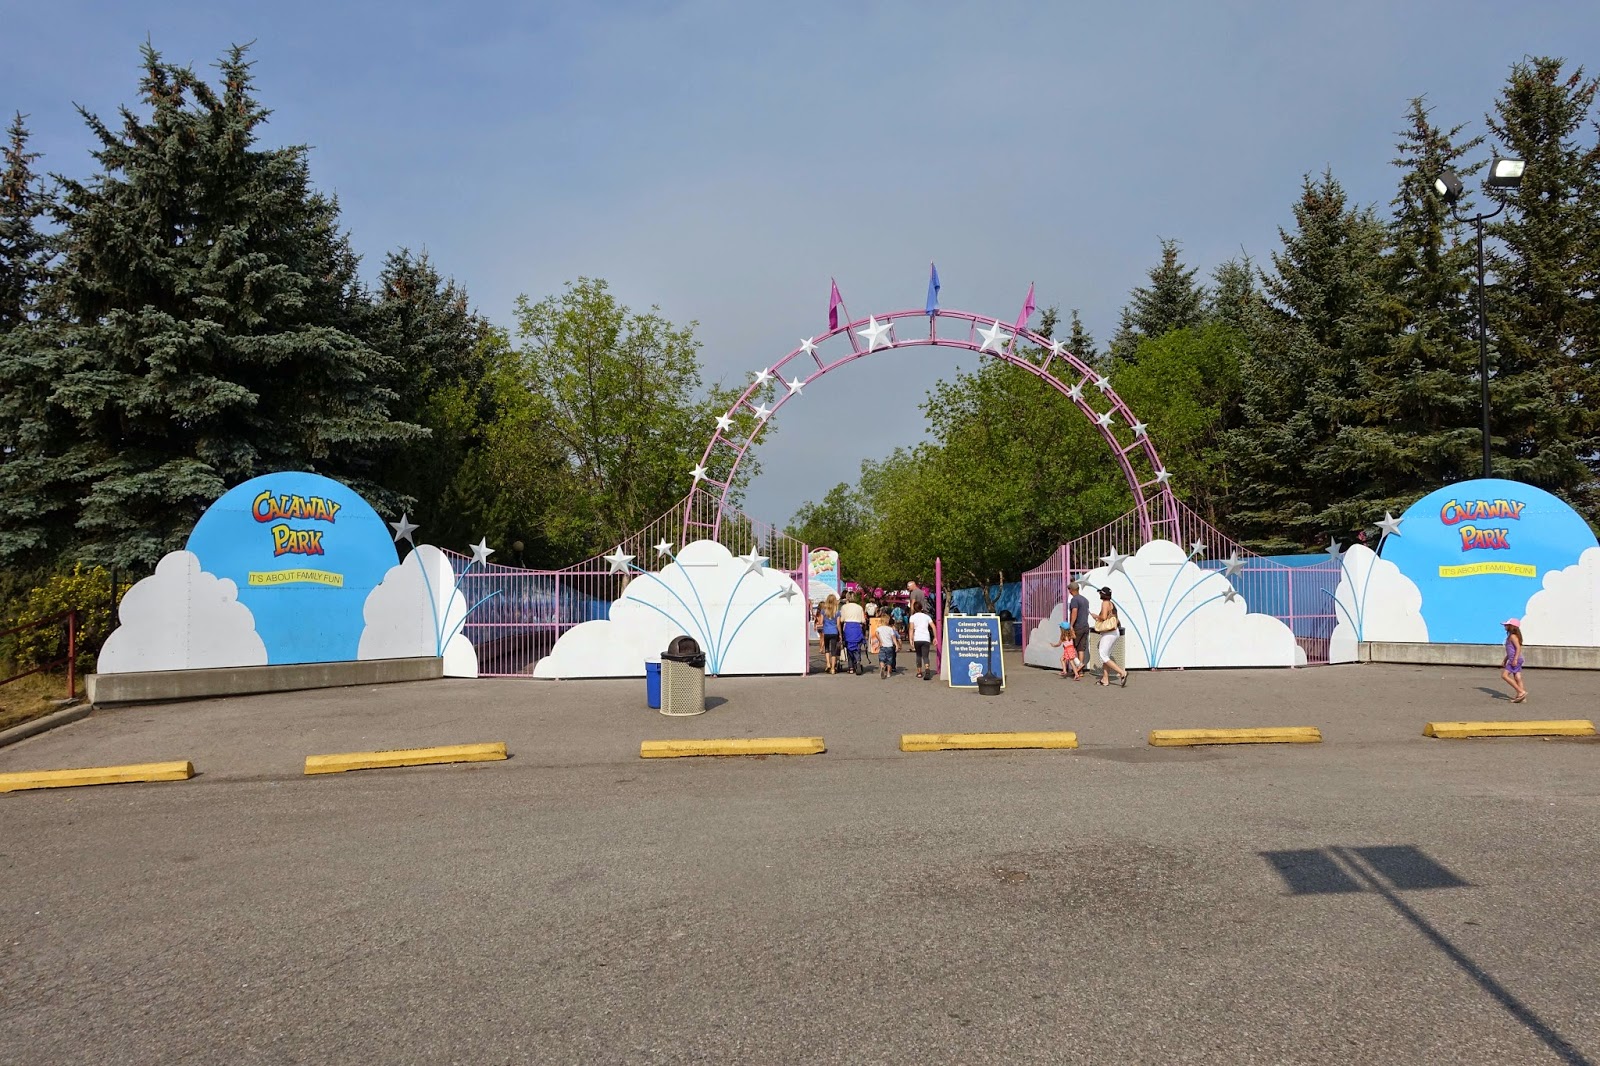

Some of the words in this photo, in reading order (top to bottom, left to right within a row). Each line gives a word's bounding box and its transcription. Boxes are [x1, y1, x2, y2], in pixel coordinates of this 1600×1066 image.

[252, 490, 341, 524] CALAWAY
[1440, 499, 1526, 526] CALAWAY
[271, 523, 325, 557] PARK
[1459, 525, 1510, 552] PARK
[249, 574, 263, 582] IT'S
[266, 572, 295, 582] ABOUT
[296, 571, 323, 580] FAMILY
[1457, 566, 1482, 574] ABOUT
[1485, 564, 1514, 572] FAMILY
[1515, 566, 1533, 575] FUN!
